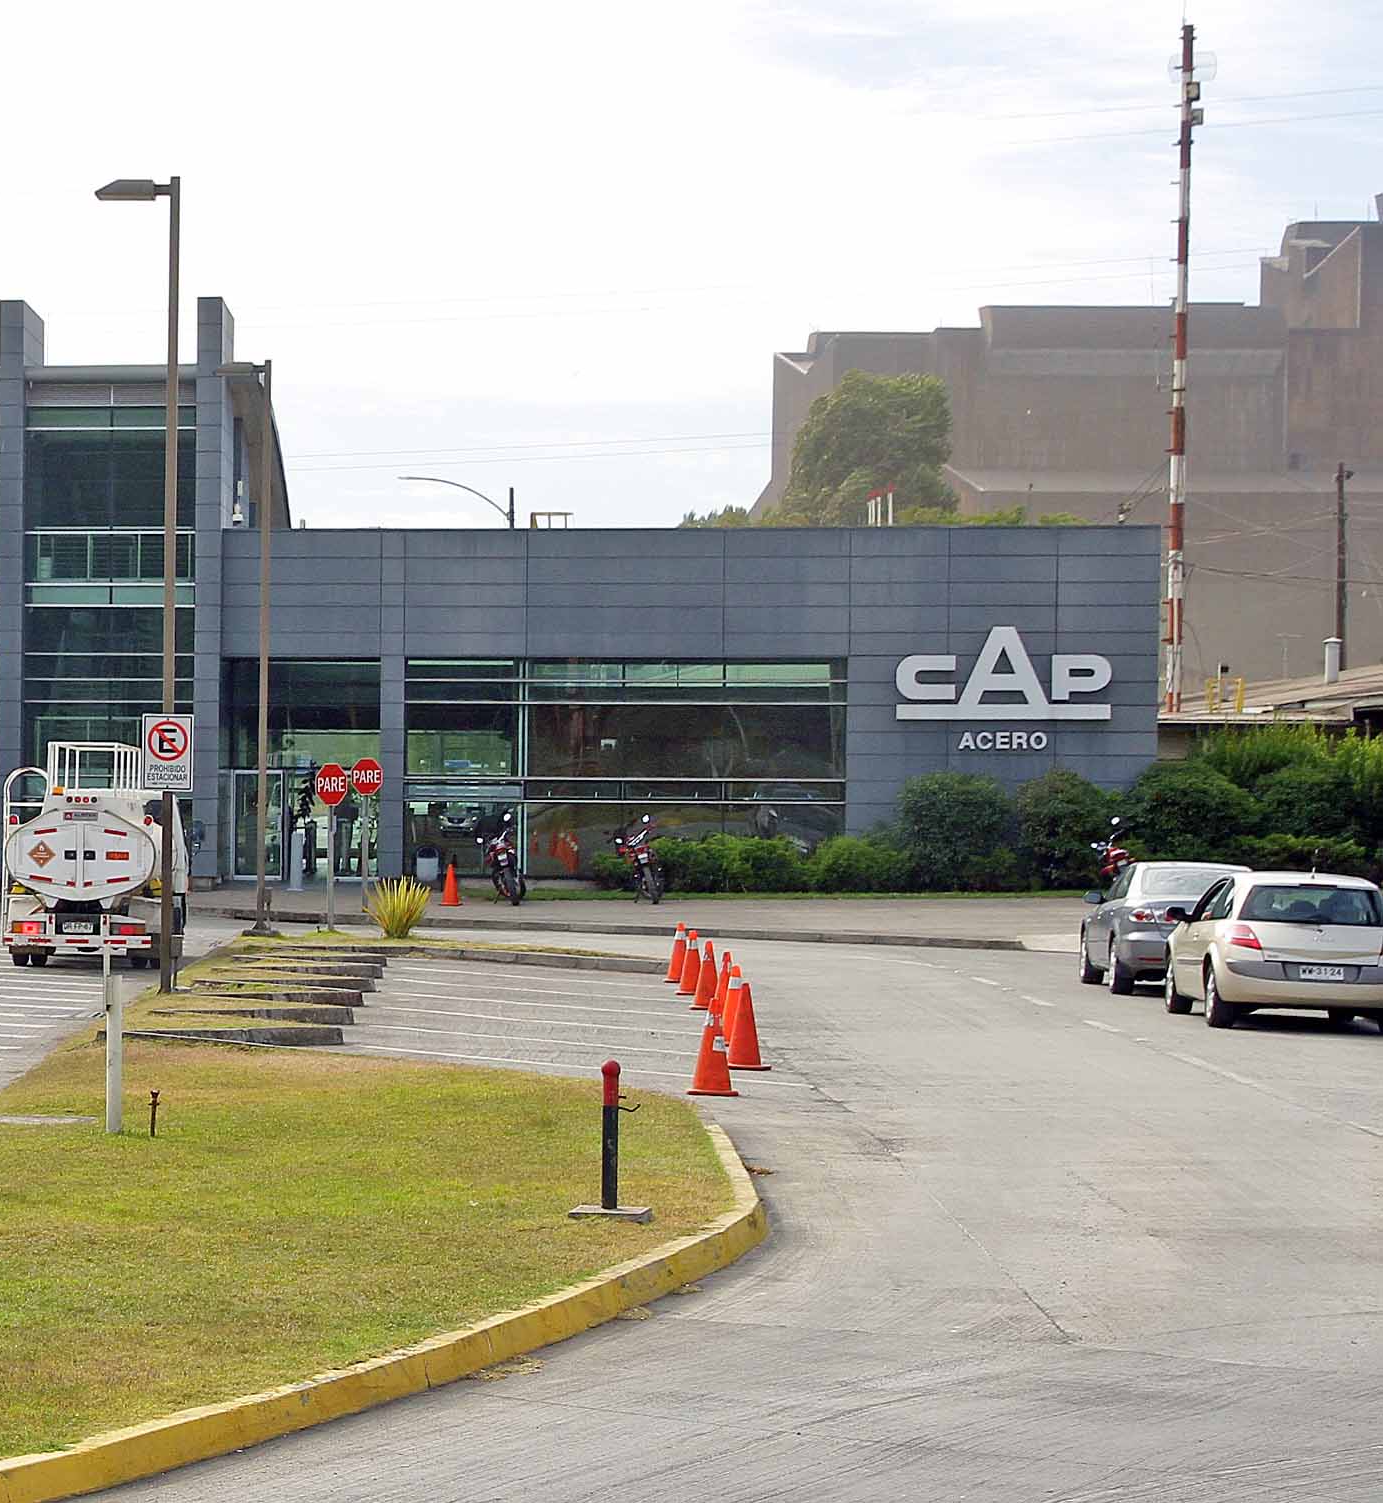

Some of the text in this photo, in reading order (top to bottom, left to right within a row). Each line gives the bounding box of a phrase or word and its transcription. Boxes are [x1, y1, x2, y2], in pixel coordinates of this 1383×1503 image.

[896, 626, 1112, 719] CAP
[159, 729, 179, 753] E
[958, 731, 1048, 750] ACERO
[147, 773, 188, 781] ESTACIONAR
[149, 764, 186, 773] PROHIBIDO
[352, 770, 381, 784] PARE
[317, 776, 346, 793] PARE
